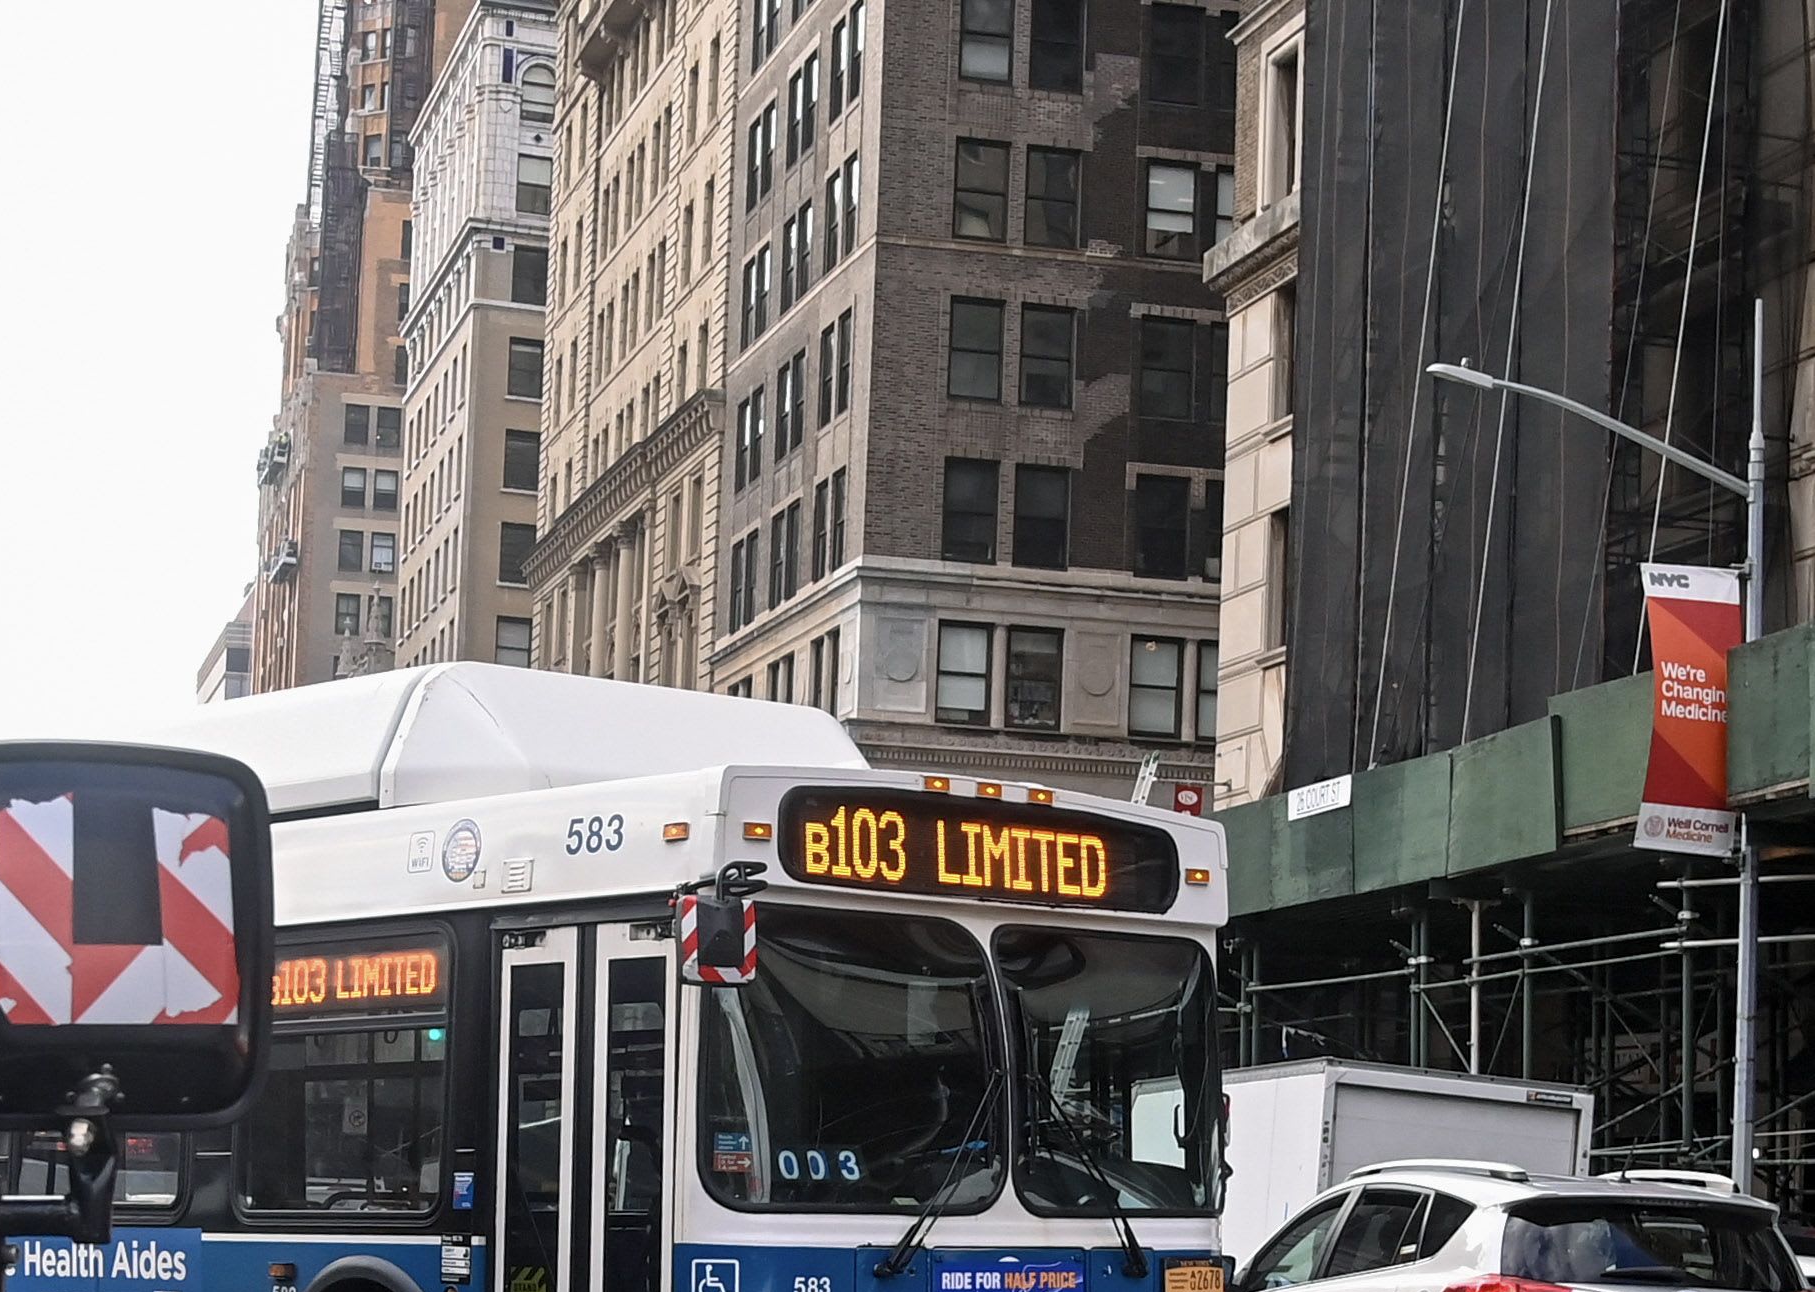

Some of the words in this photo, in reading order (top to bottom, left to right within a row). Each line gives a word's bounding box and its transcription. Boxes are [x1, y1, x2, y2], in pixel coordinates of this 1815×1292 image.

[1649, 572, 1690, 589] NYC
[1661, 661, 1706, 683] We're
[1661, 680, 1727, 704] Changin
[1305, 784, 1331, 810] COURT
[1331, 780, 1341, 802] ST
[565, 813, 625, 856] 583
[1666, 828, 1713, 843] Medicine
[1693, 819, 1729, 834] Cornell
[804, 805, 906, 883] B103
[937, 819, 1106, 898] LIMITED
[336, 953, 436, 999] LIMITED
[24, 1240, 104, 1278] Health
[111, 1240, 187, 1281] Aides
[941, 1271, 973, 1290] RIDE
[975, 1271, 1002, 1290] FOR
[1004, 1271, 1037, 1290] HALF
[1039, 1271, 1077, 1288] PRICE
[1197, 1269, 1221, 1291] 2678
